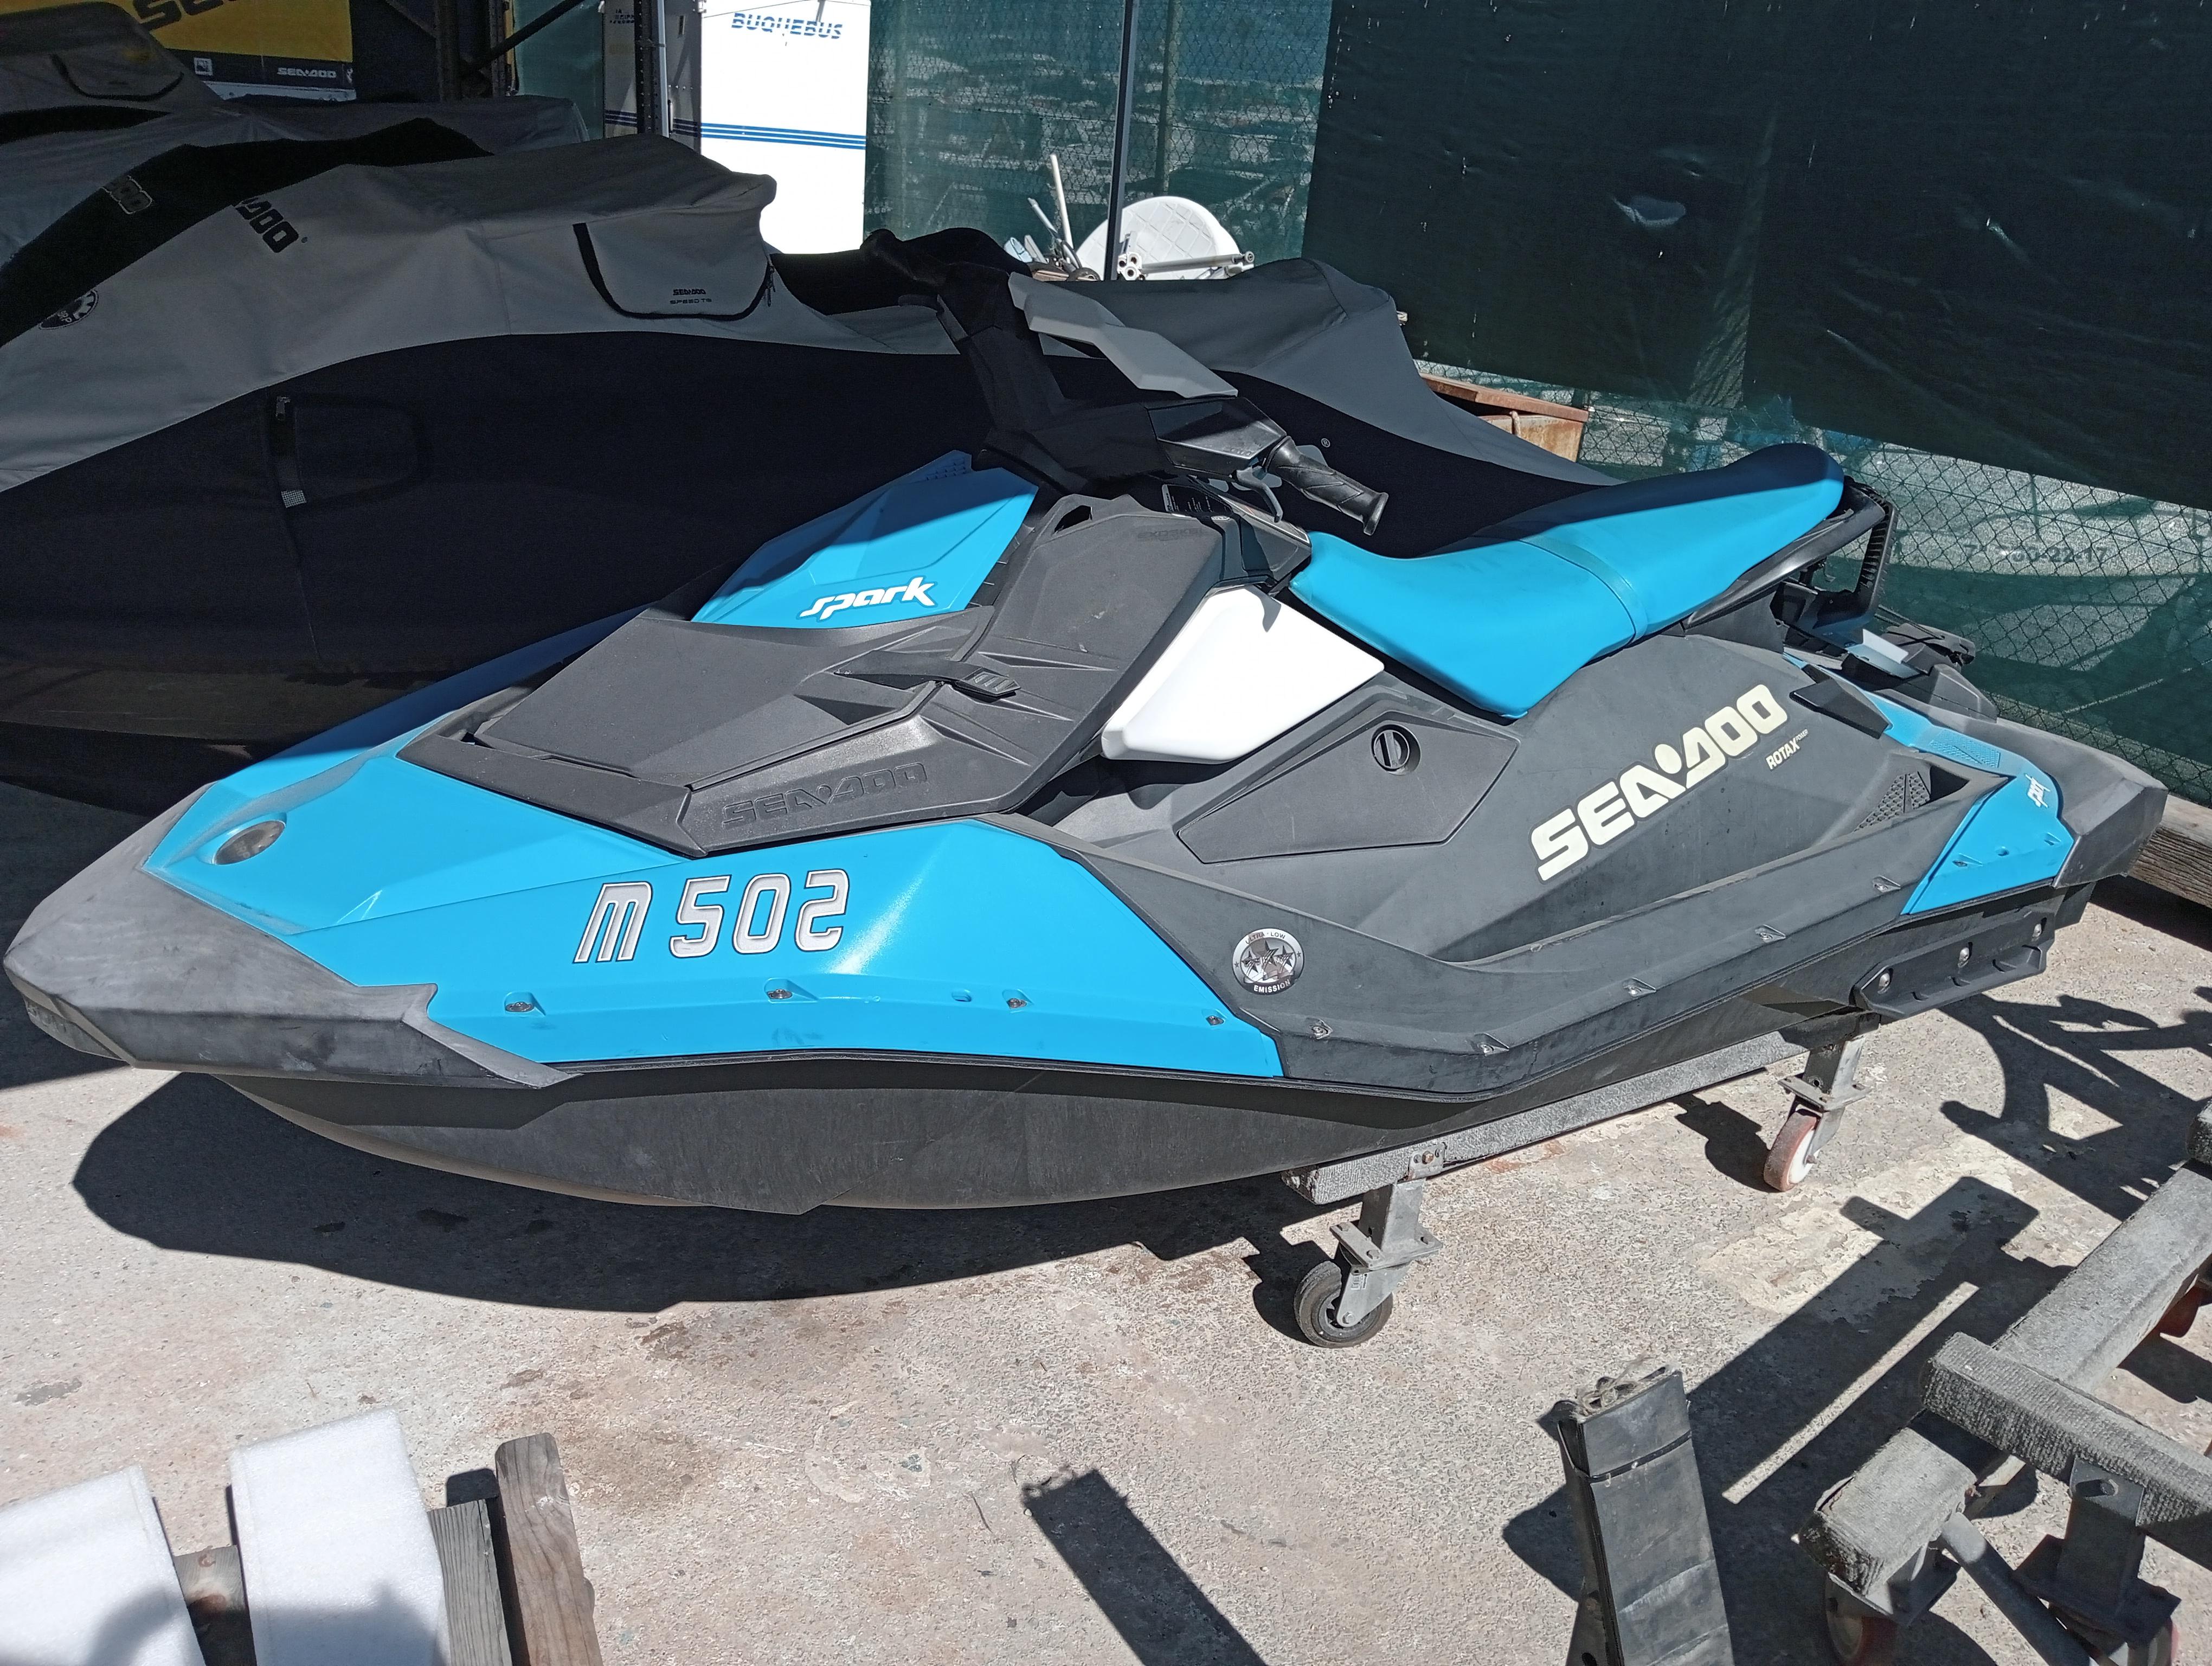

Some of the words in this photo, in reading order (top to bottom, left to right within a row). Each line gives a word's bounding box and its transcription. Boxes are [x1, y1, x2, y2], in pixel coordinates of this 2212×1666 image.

[731, 13, 843, 39] BUQUEBUS
[1766, 737, 1800, 770] ROTAX
[573, 881, 653, 963] M
[669, 869, 850, 958] 502
[1245, 932, 1265, 944] ULTRA
[1270, 931, 1285, 940] LOW
[1253, 979, 1291, 993] EMISSION
